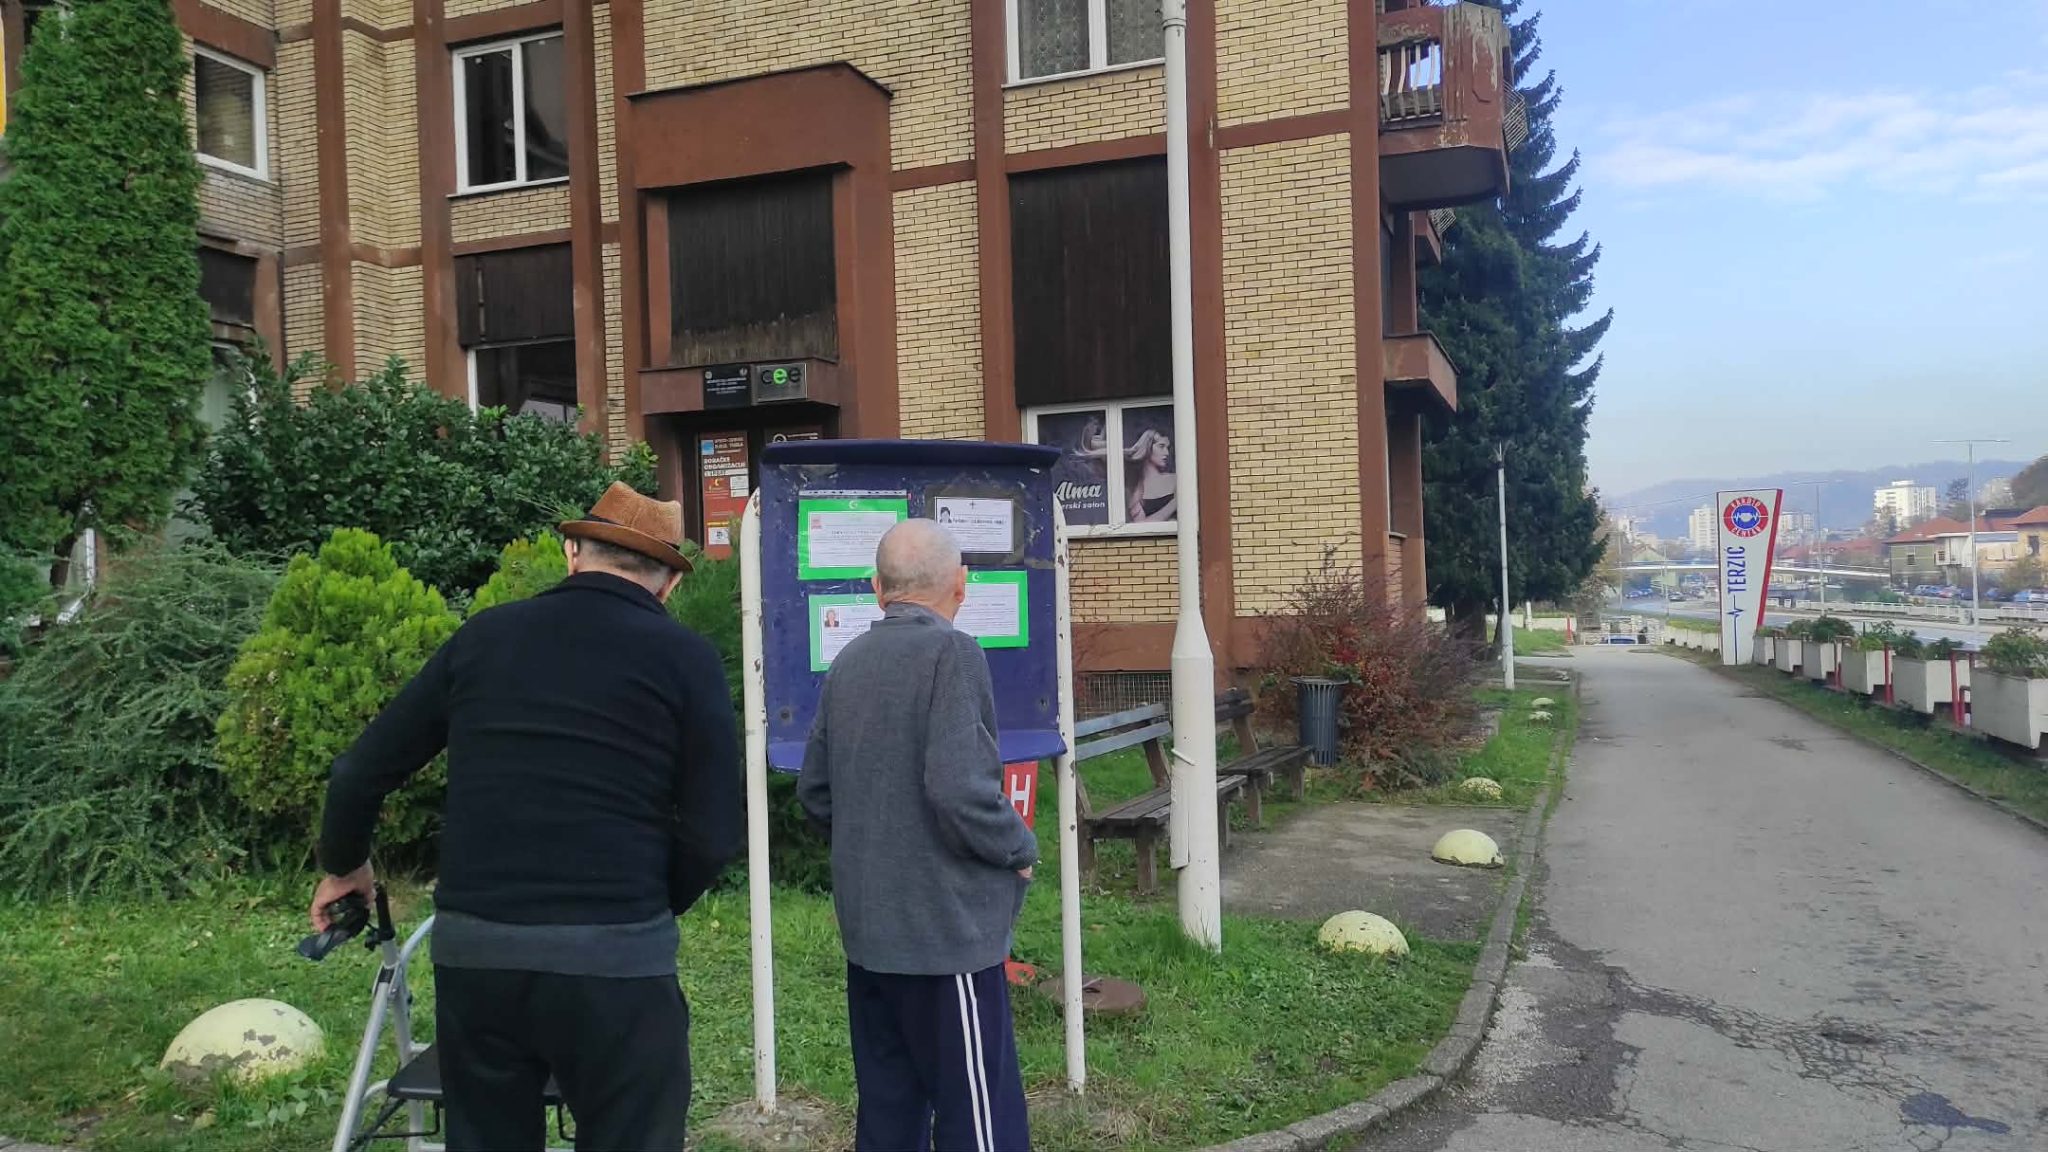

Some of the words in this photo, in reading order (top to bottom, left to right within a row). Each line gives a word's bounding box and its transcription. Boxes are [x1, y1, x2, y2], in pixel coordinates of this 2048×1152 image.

[1056, 481, 1102, 501] Alma
[1062, 501, 1081, 510] erski
[1082, 501, 1106, 509] salon
[1724, 546, 1746, 594] TERZIĆ
[1011, 774, 1031, 817] H
